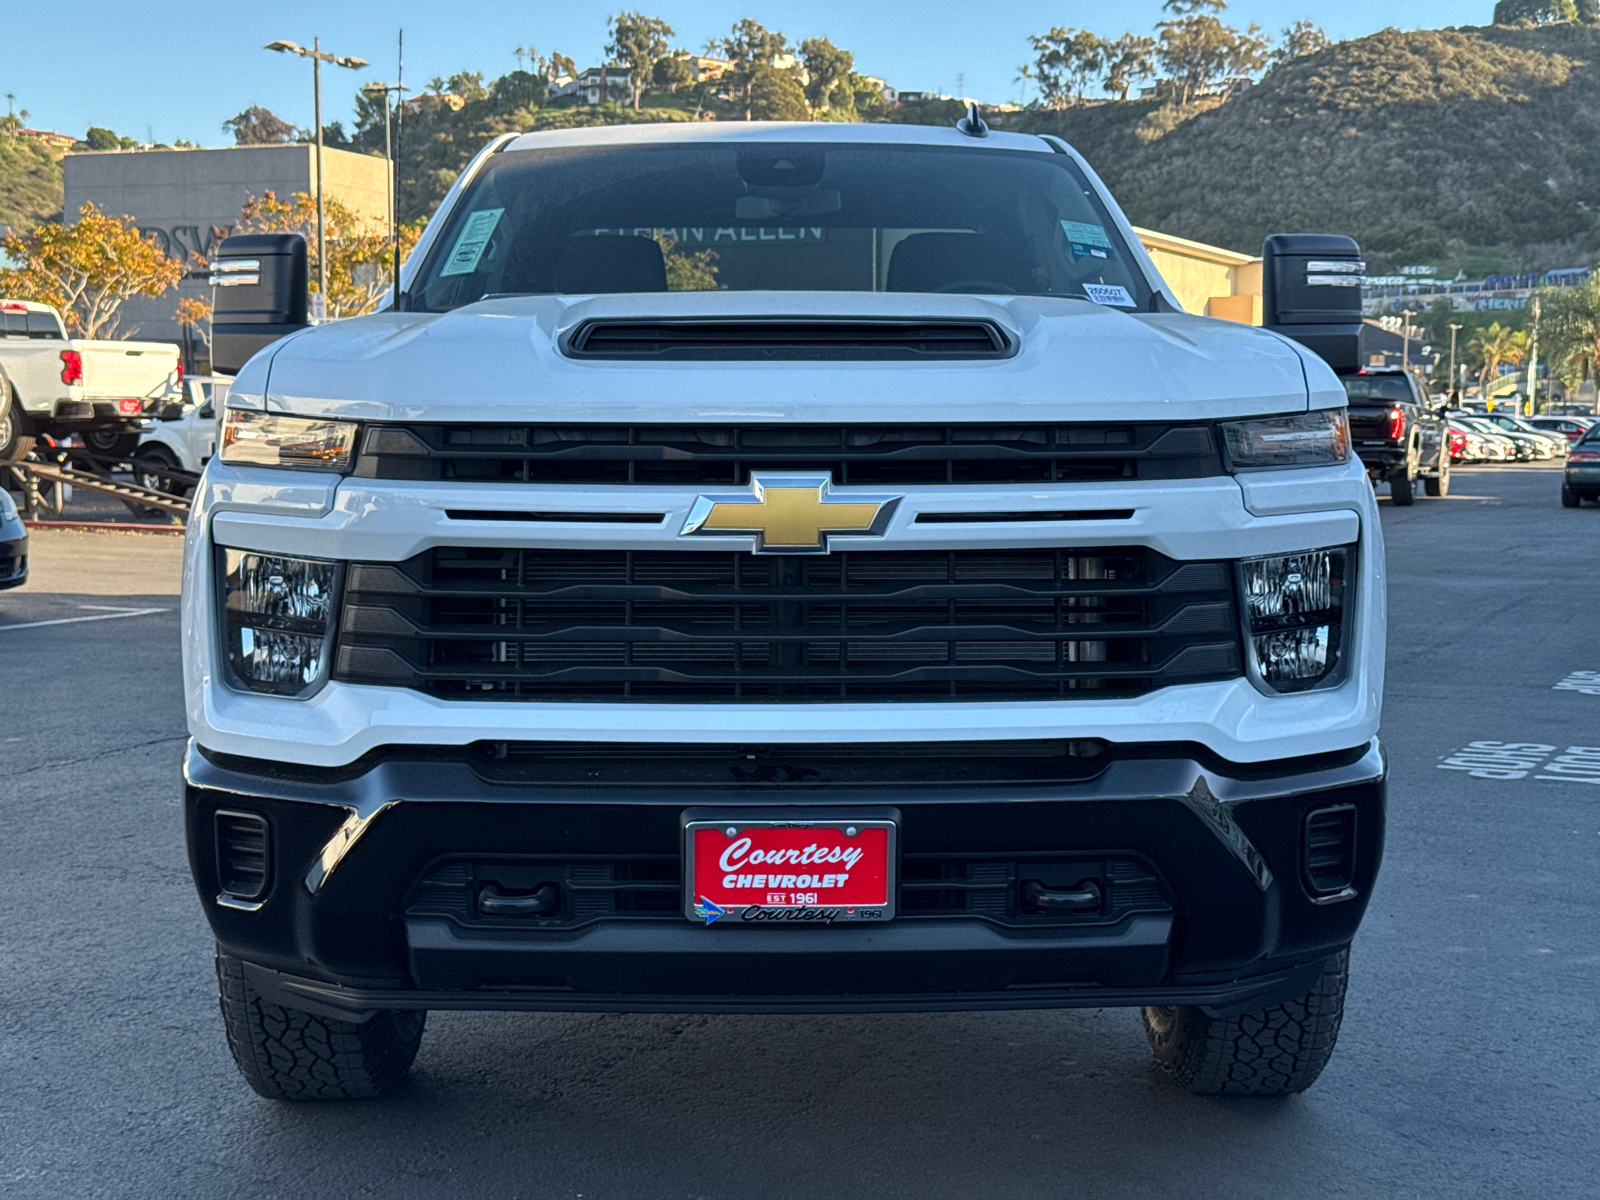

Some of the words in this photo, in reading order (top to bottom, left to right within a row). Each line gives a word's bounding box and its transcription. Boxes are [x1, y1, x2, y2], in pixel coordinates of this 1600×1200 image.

[1437, 740, 1557, 779] SHOP
[719, 837, 864, 872] Courtesy
[722, 873, 849, 888] CHEVROLET
[767, 894, 786, 903] EST
[790, 893, 817, 904] 1961
[741, 904, 840, 924] Courtesy
[859, 909, 882, 919] 1961
